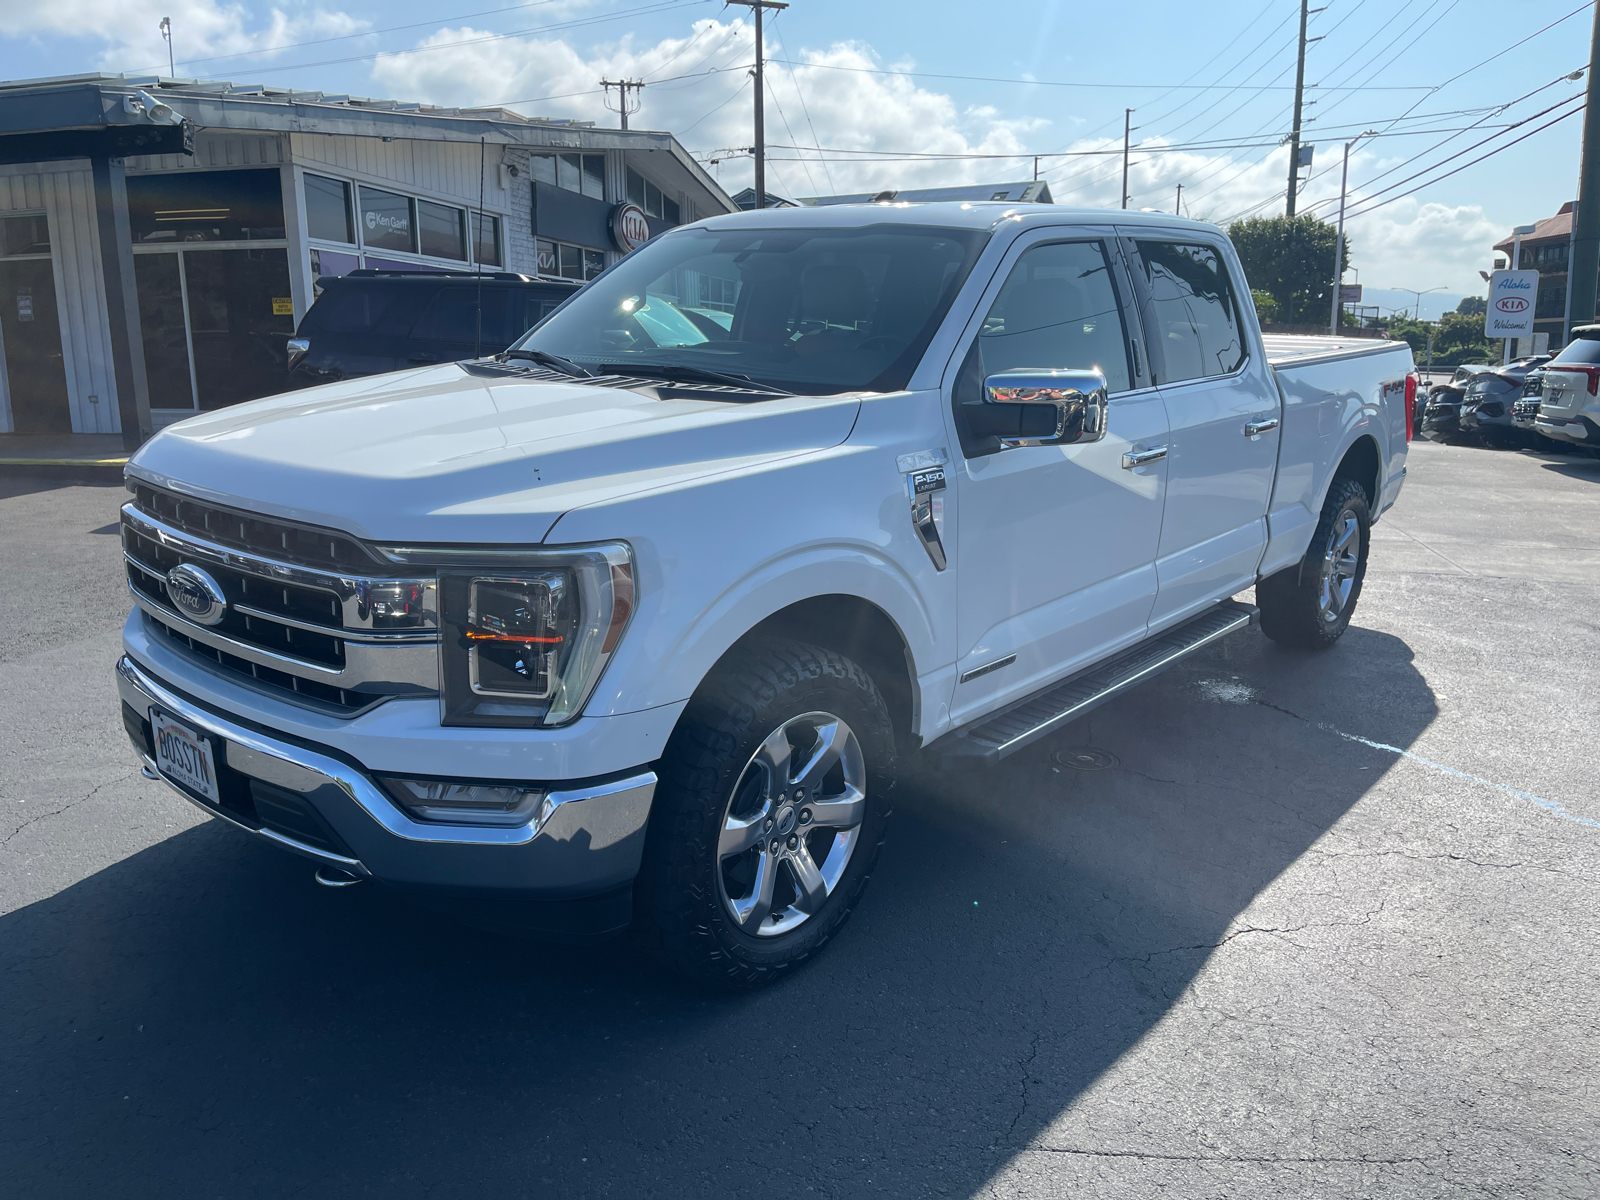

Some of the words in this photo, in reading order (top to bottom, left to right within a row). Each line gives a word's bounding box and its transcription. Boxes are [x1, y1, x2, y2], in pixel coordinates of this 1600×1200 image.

[375, 213, 390, 227] Ken
[390, 216, 408, 230] Garff
[625, 215, 648, 242] KIA
[1497, 278, 1531, 290] Aloha
[1501, 300, 1524, 309] KIA
[1493, 319, 1529, 330] Welcome!
[914, 472, 944, 486] F-150
[917, 482, 937, 492] LARIAT
[173, 584, 201, 609] Ford
[157, 726, 210, 785] BOSSTN
[187, 776, 202, 790] STATE
